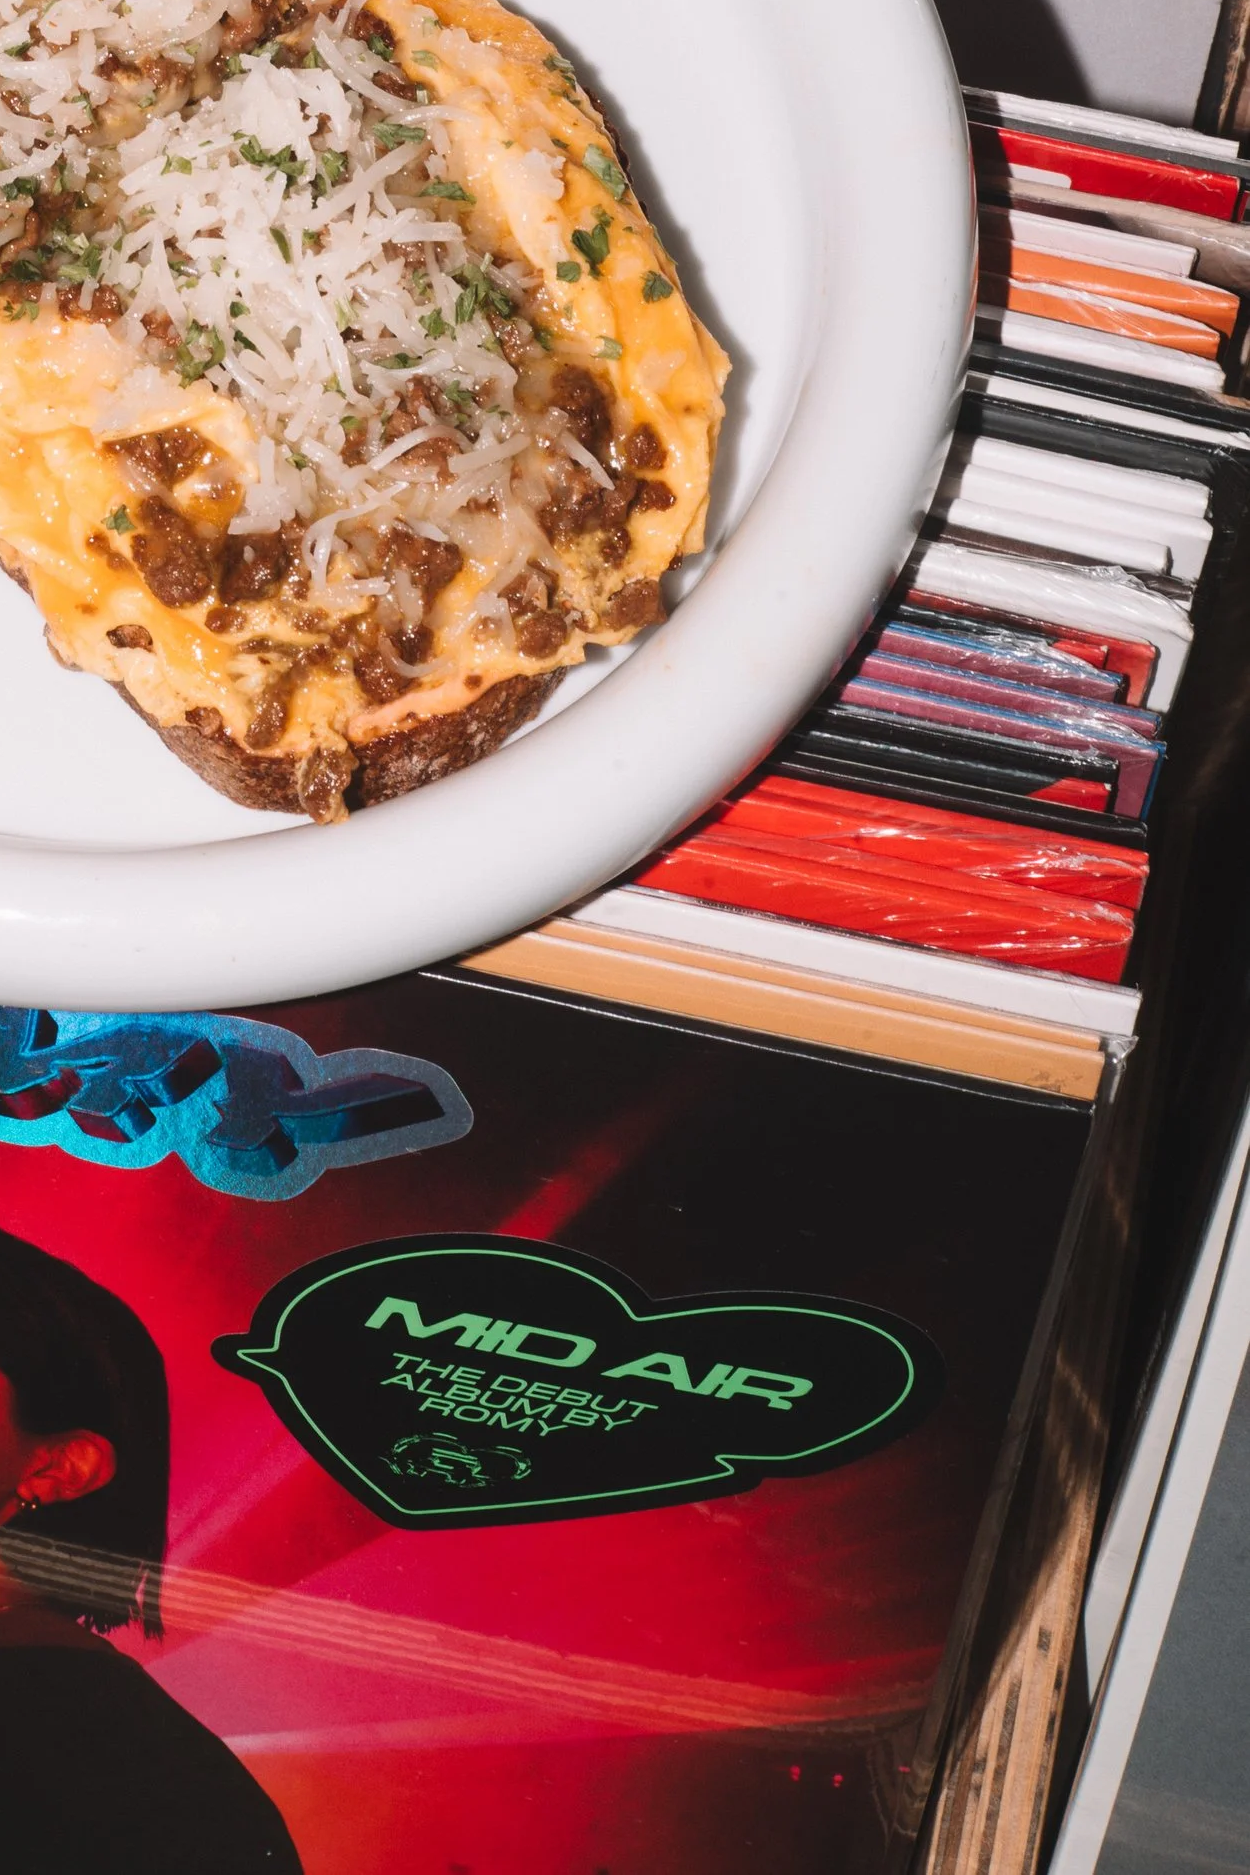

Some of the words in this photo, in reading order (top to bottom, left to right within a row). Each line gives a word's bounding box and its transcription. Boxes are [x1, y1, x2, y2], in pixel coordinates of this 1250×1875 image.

[363, 1296, 598, 1368] MID
[600, 1351, 814, 1411] AIR
[379, 1373, 557, 1420] ALBUM
[561, 1406, 634, 1432] BY
[391, 1352, 486, 1387] THE
[489, 1374, 660, 1419] DEBUT
[417, 1395, 569, 1437] ROMY
